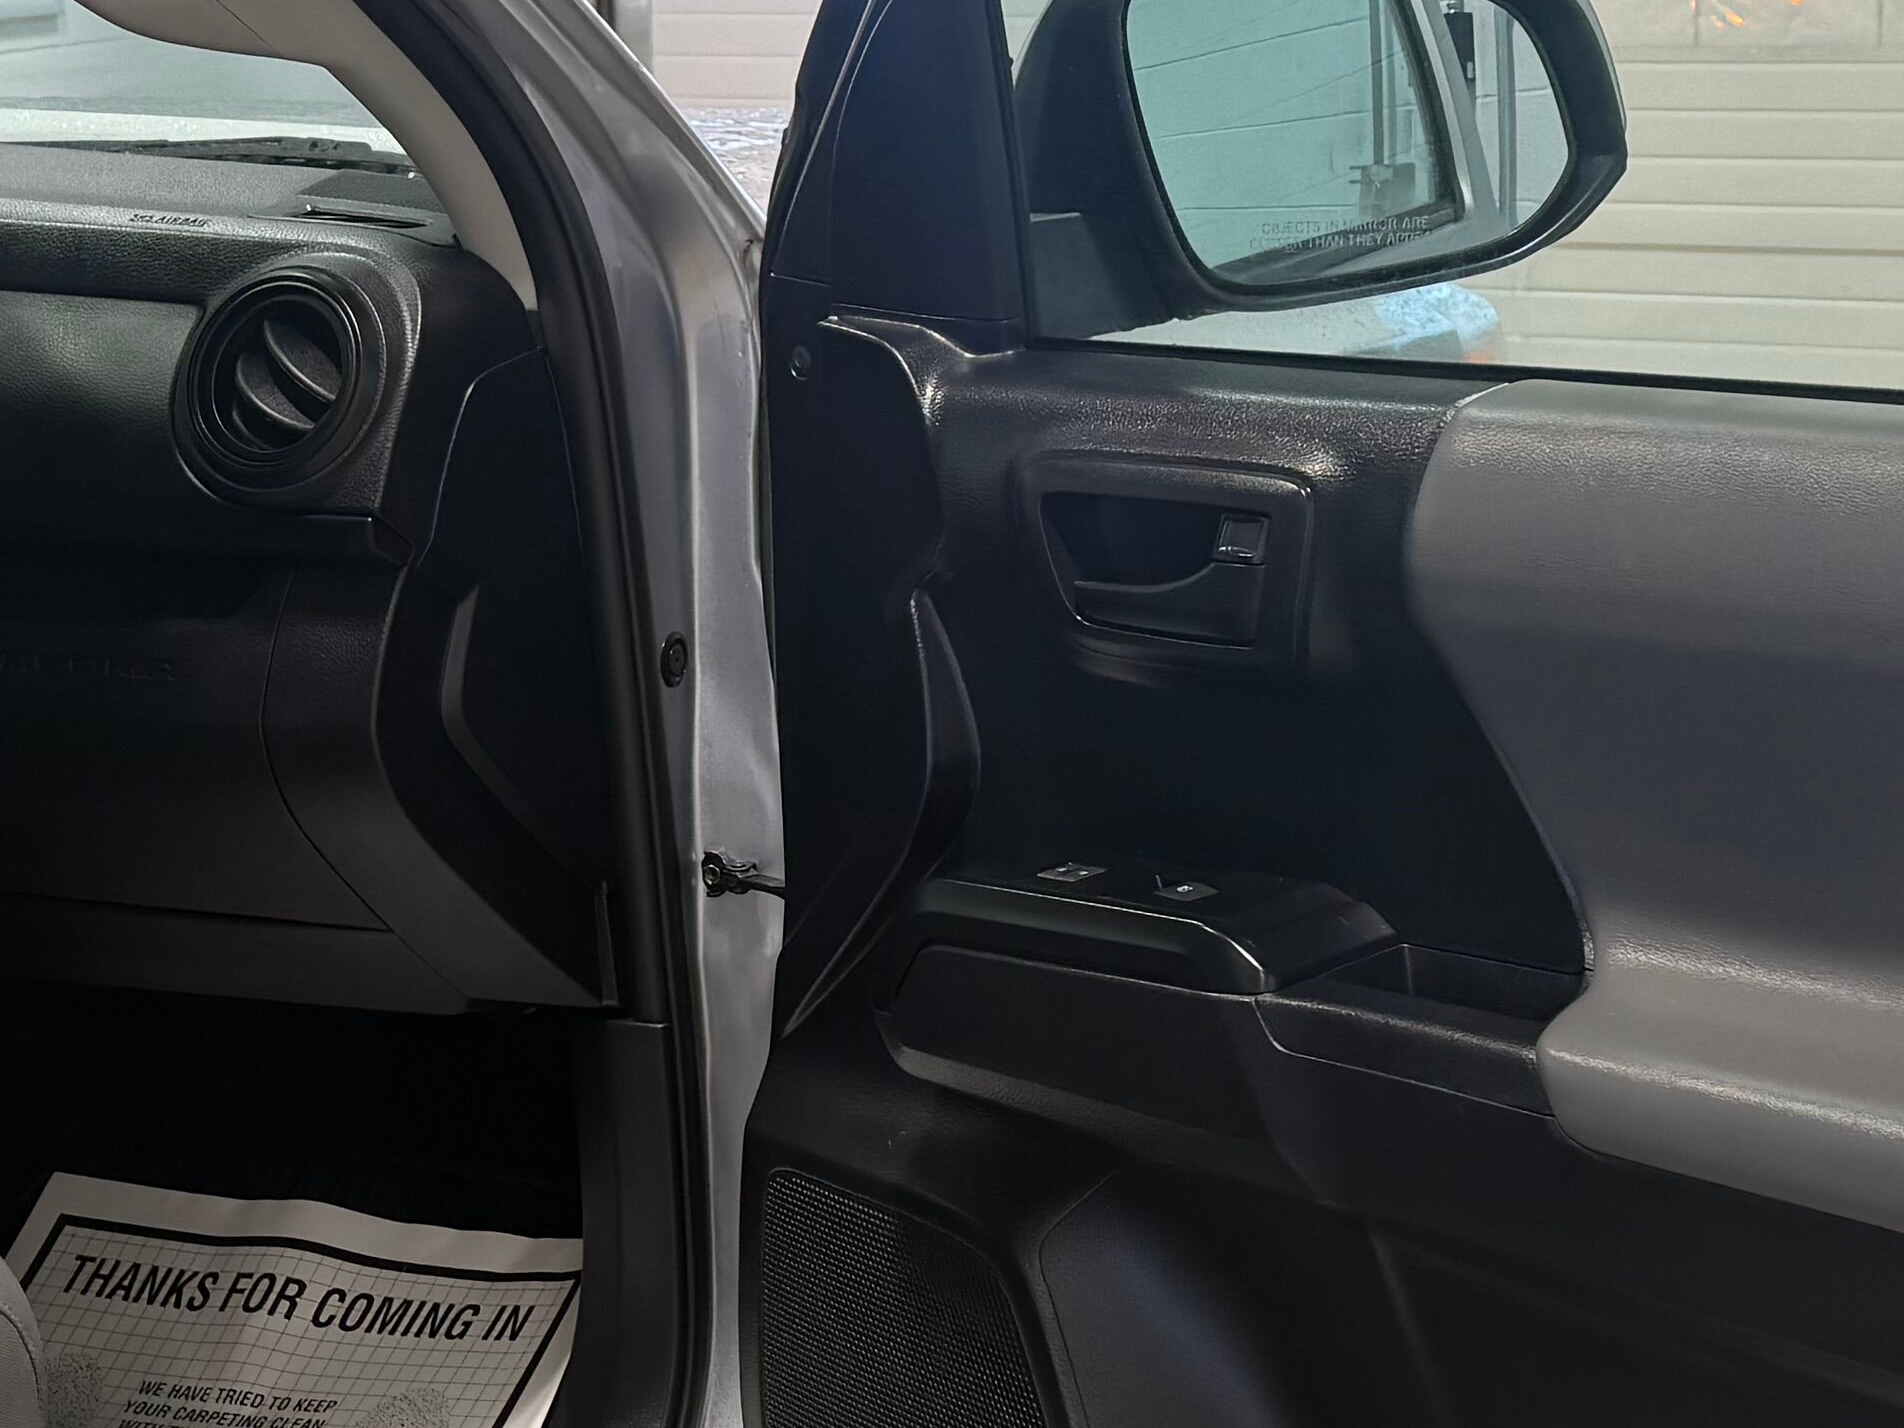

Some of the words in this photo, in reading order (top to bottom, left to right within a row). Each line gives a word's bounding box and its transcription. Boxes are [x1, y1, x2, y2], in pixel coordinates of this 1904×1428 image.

[1402, 215, 1430, 230] ARE
[1308, 233, 1344, 249] THAN
[1347, 232, 1383, 247] THEY
[62, 1254, 218, 1313] THANKS
[219, 1271, 308, 1322] FOR
[311, 1286, 480, 1341] COMING
[481, 1303, 535, 1342] IN
[138, 1380, 168, 1397] WE
[168, 1384, 213, 1403] HAVE
[215, 1388, 265, 1409] TRIED
[268, 1396, 291, 1411] TO
[293, 1398, 338, 1414] KEEP
[123, 1400, 172, 1418] YOUR
